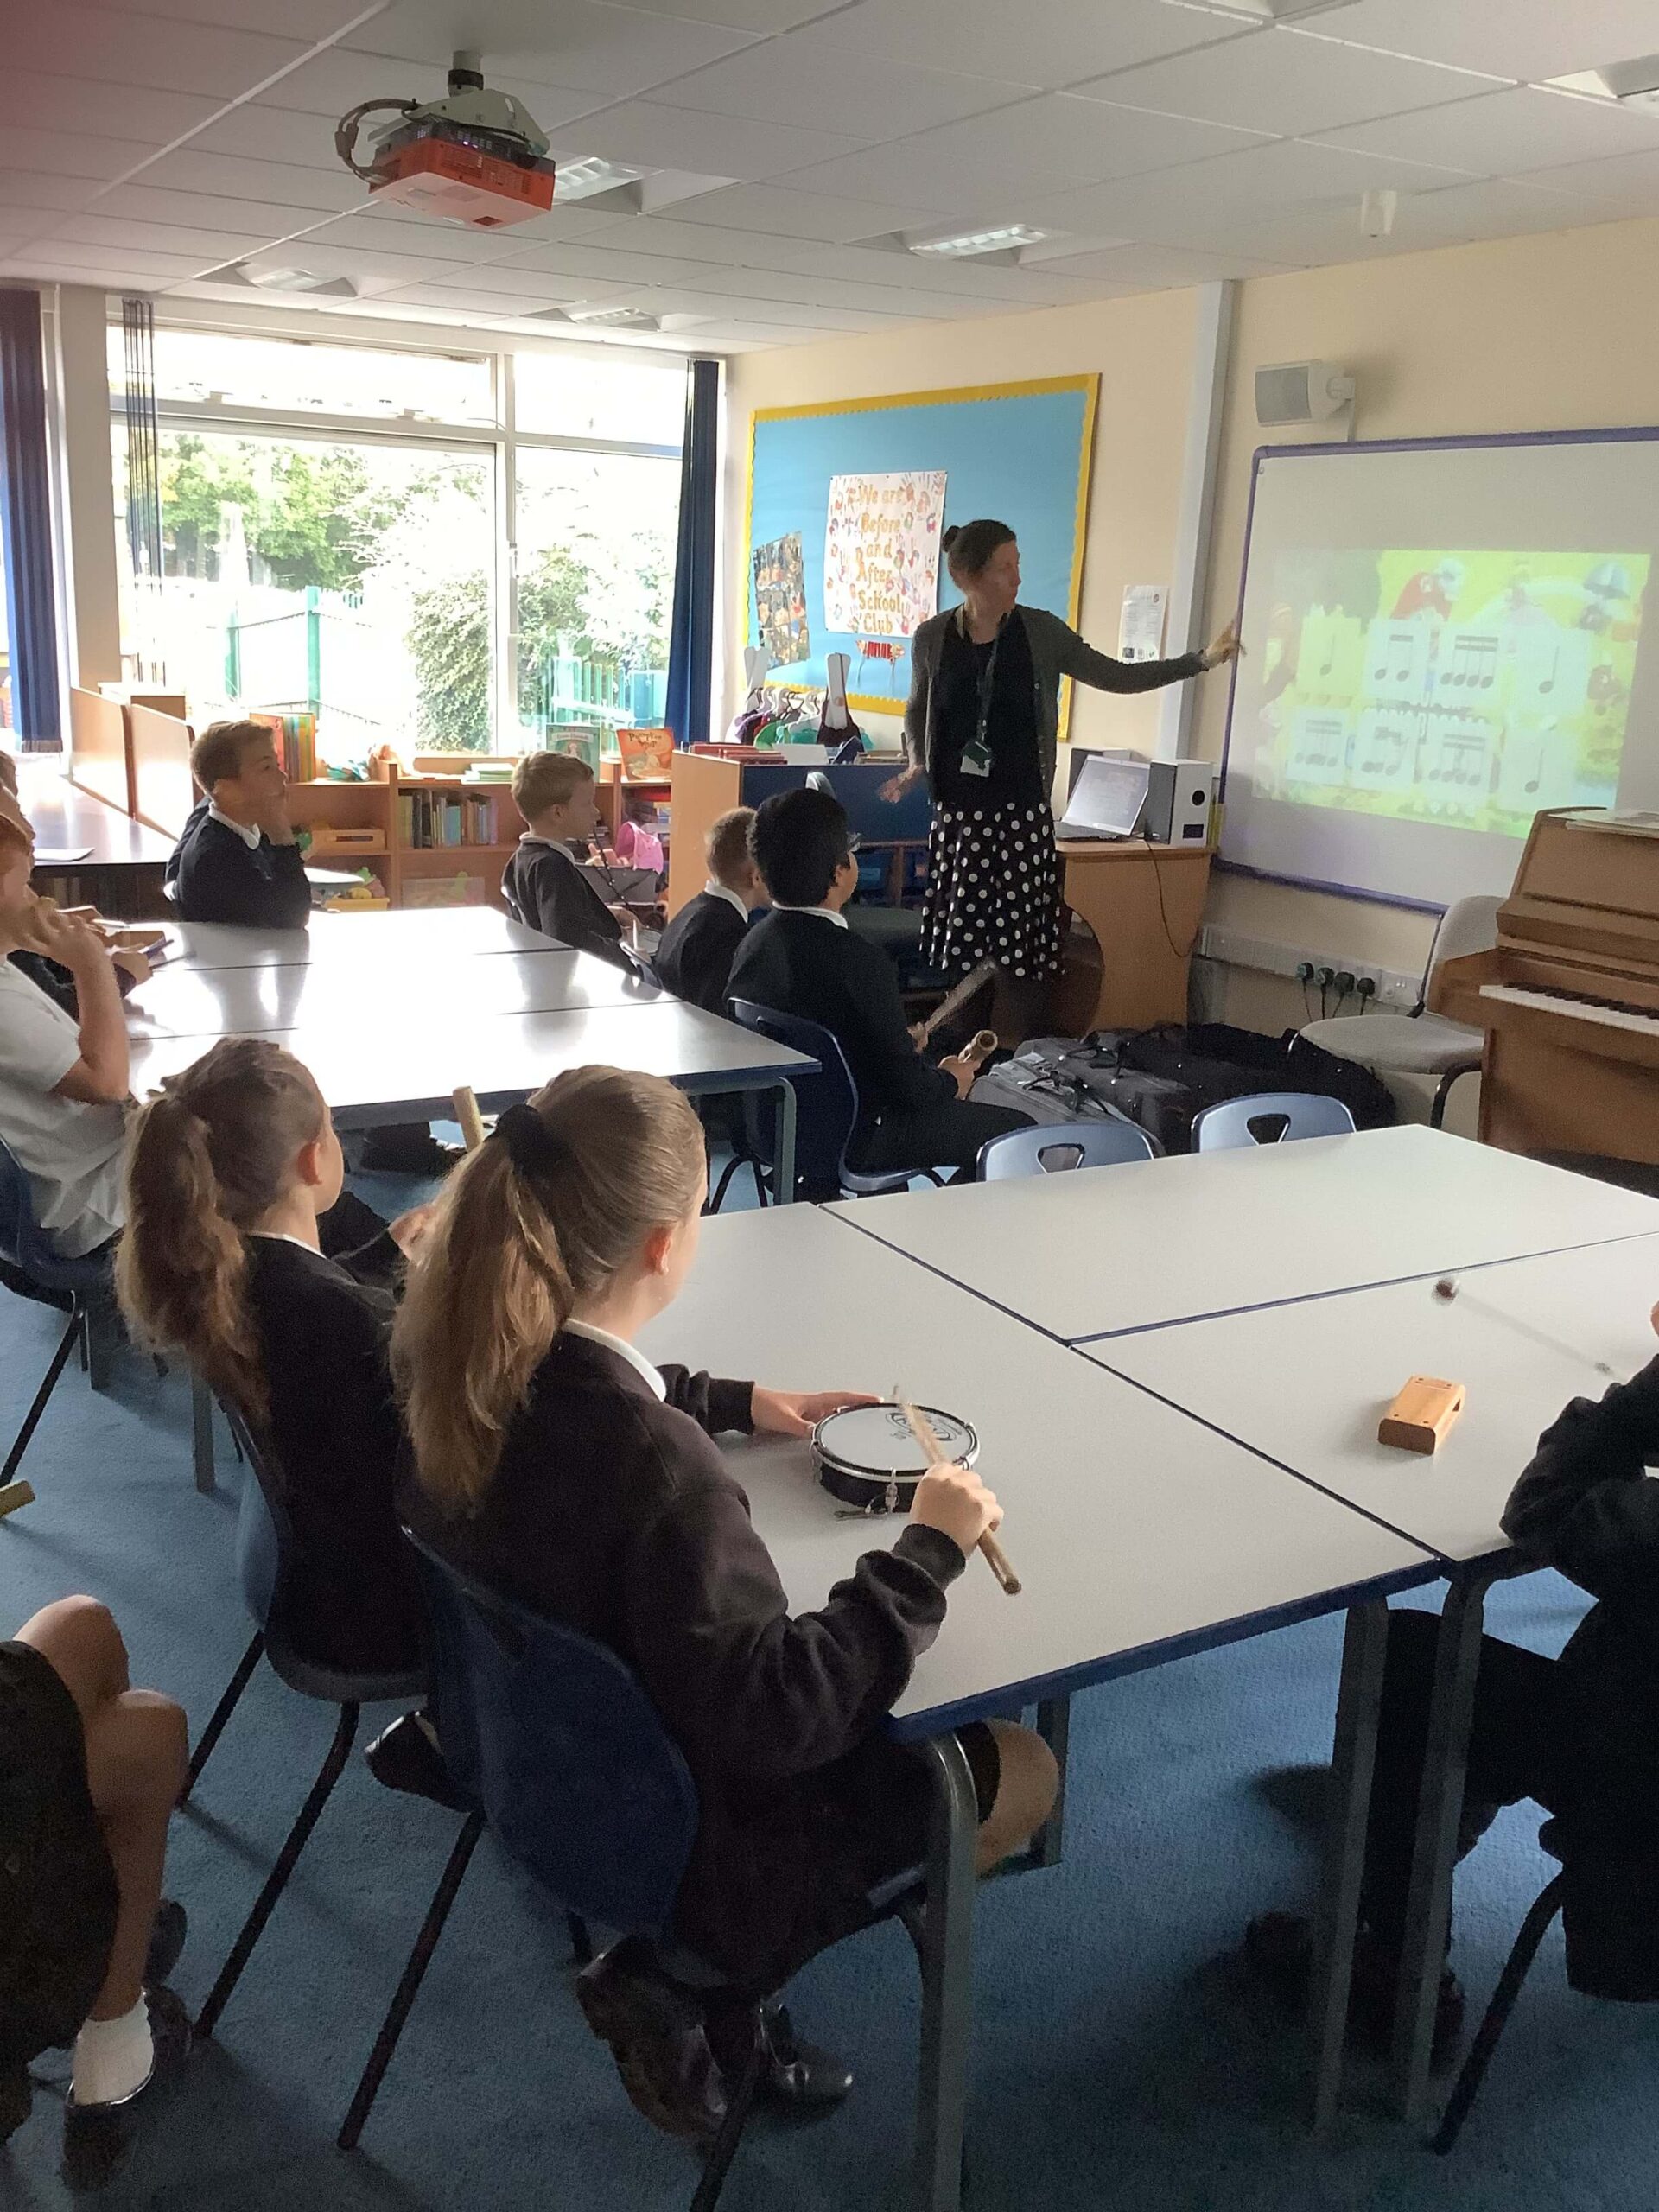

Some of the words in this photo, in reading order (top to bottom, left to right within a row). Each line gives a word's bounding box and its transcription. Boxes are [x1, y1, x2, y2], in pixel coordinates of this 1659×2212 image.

[859, 484, 878, 504] We
[861, 512, 901, 542] Before
[866, 538, 893, 559] and
[855, 546, 892, 588] After
[858, 590, 902, 613] School
[863, 612, 893, 635] Club
